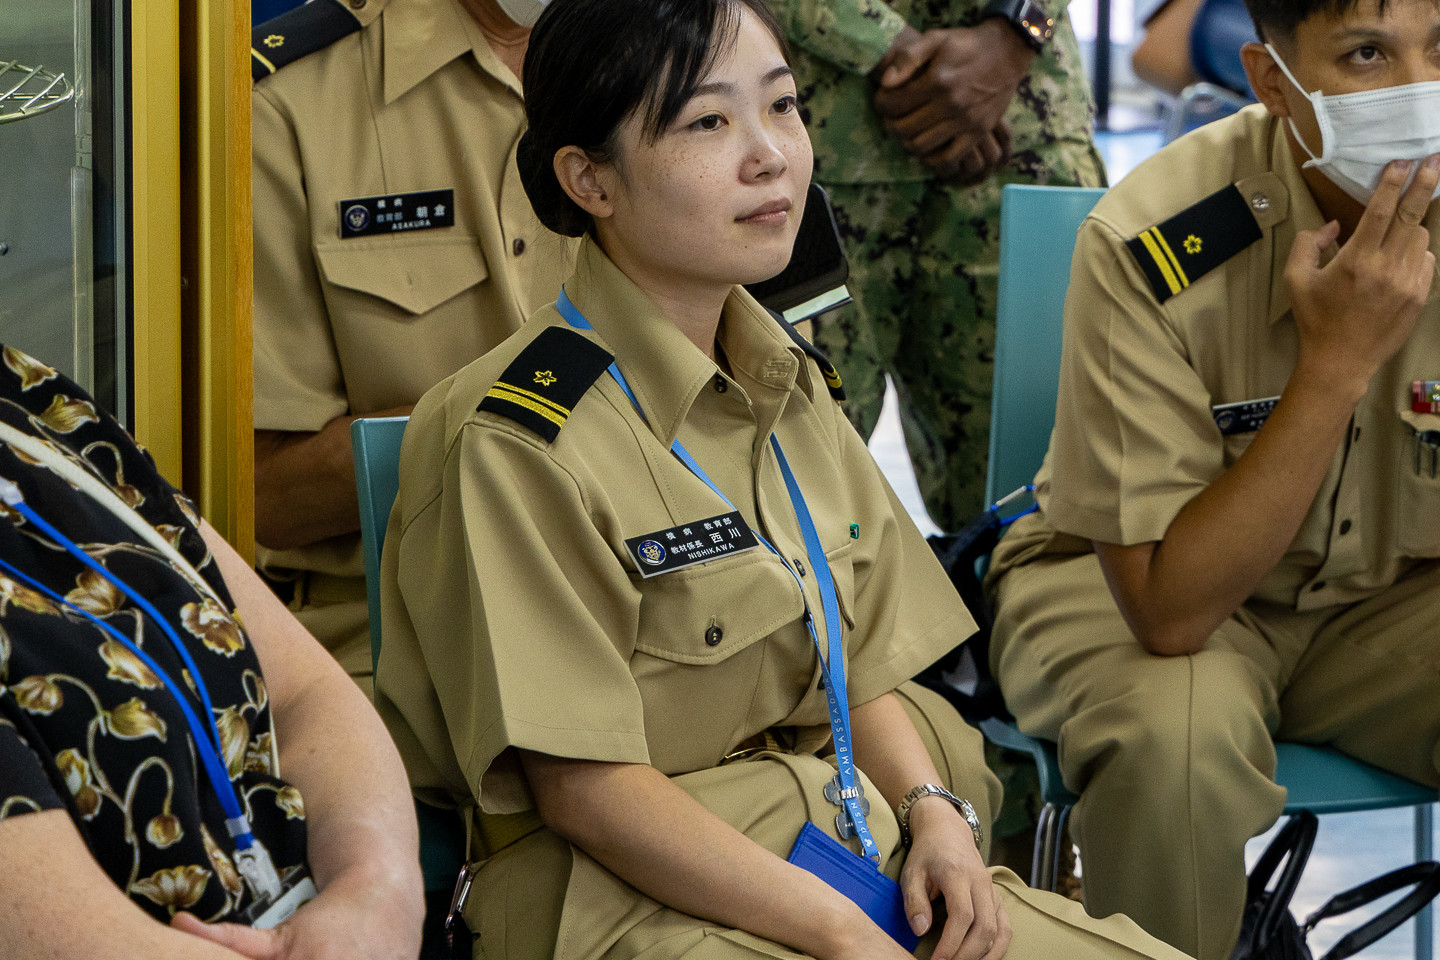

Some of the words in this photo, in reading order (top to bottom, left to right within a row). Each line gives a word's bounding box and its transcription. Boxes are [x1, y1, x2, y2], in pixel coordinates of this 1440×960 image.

[391, 219, 432, 231] ASAKURA
[708, 526, 742, 544] 西川
[687, 542, 735, 560] NISHIKAWA
